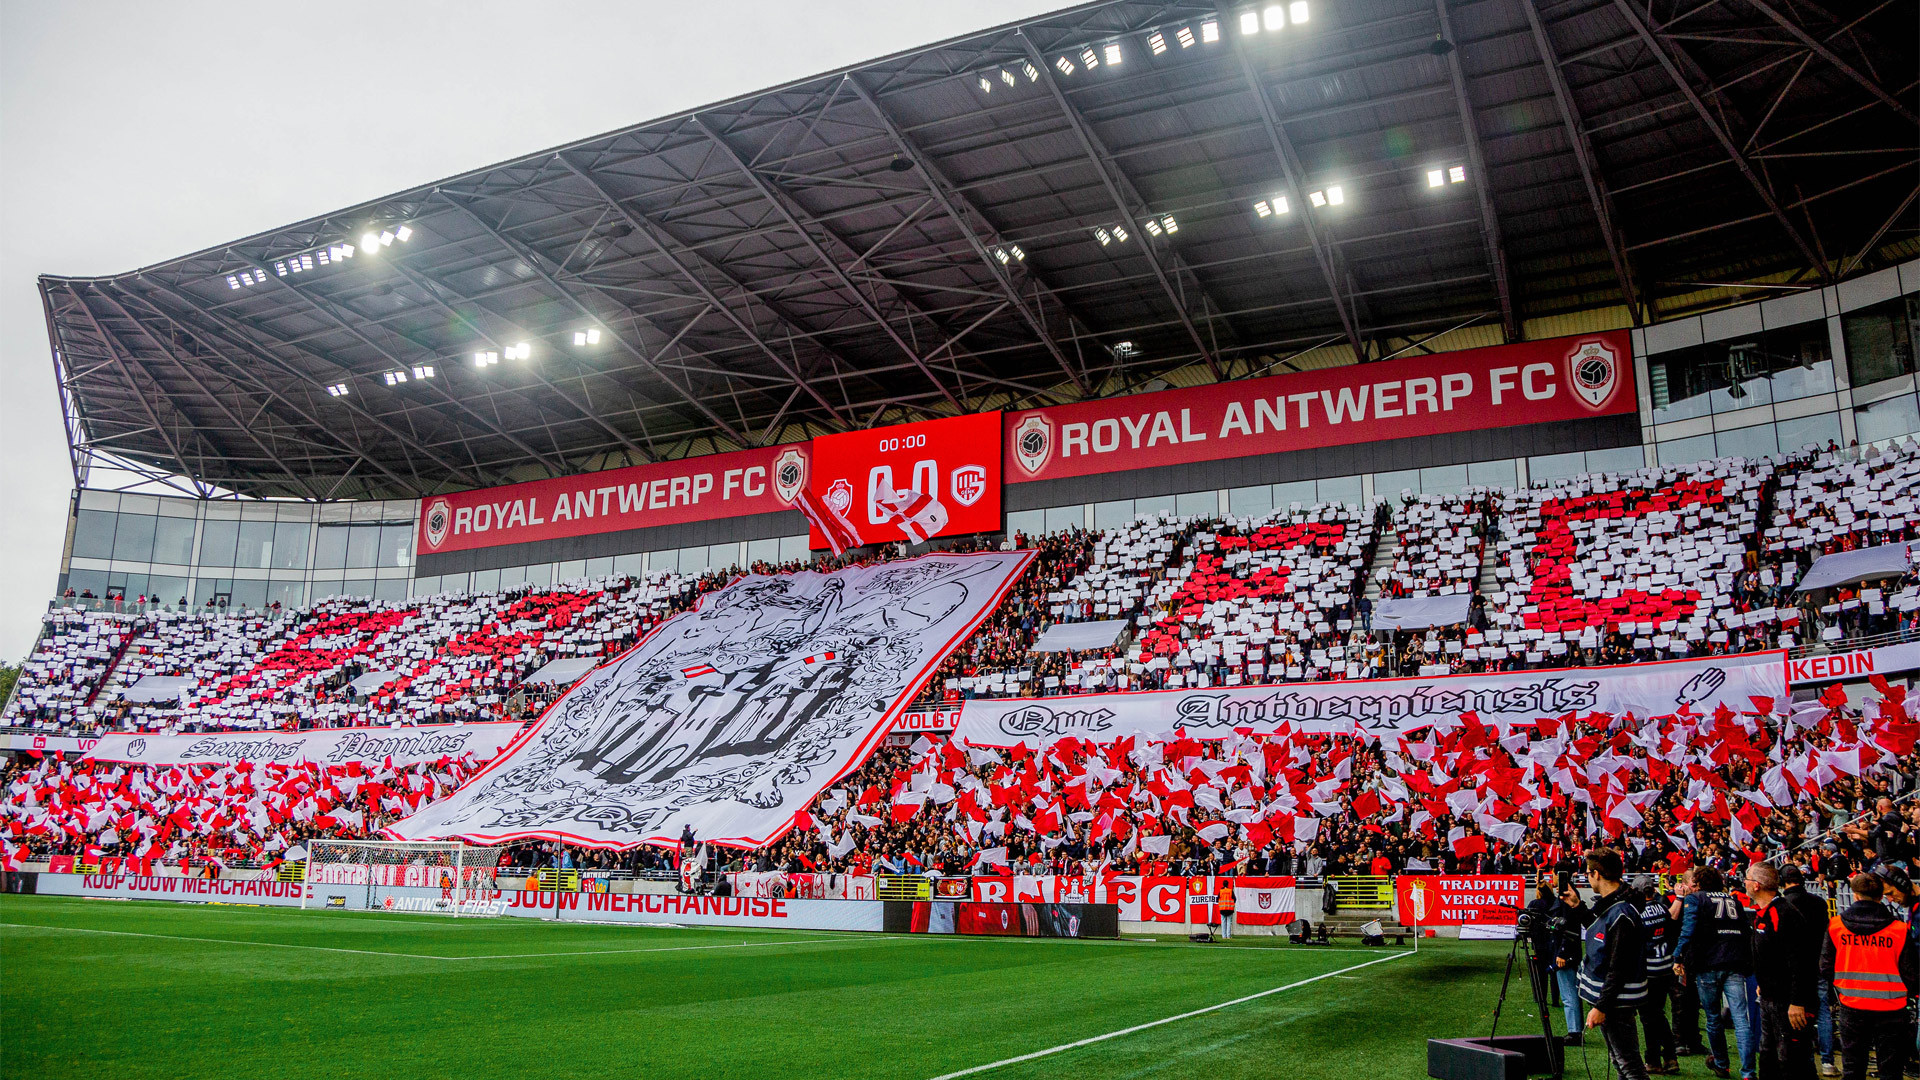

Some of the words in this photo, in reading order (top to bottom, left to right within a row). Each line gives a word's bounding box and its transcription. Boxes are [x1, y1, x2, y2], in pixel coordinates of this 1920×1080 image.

[1062, 408, 1206, 458] ROYAL
[1218, 372, 1473, 439] ANTWERP
[1490, 362, 1556, 406] FC
[454, 496, 544, 535] ROYAL
[551, 473, 714, 523] ANTWERP
[722, 466, 766, 500] FC
[1790, 651, 1874, 682] KEDIN
[898, 712, 945, 730] VOLG
[77, 739, 97, 751] VO
[327, 730, 474, 762] Populus
[1439, 880, 1519, 891] TRADITIE
[588, 892, 788, 918] MERCHANDISE
[1440, 894, 1519, 906] VERGAAT
[1710, 897, 1739, 920] 76
[1441, 909, 1479, 920] NIET
[1640, 903, 1666, 919] MEDIA
[1840, 933, 1893, 948] STEWARD
